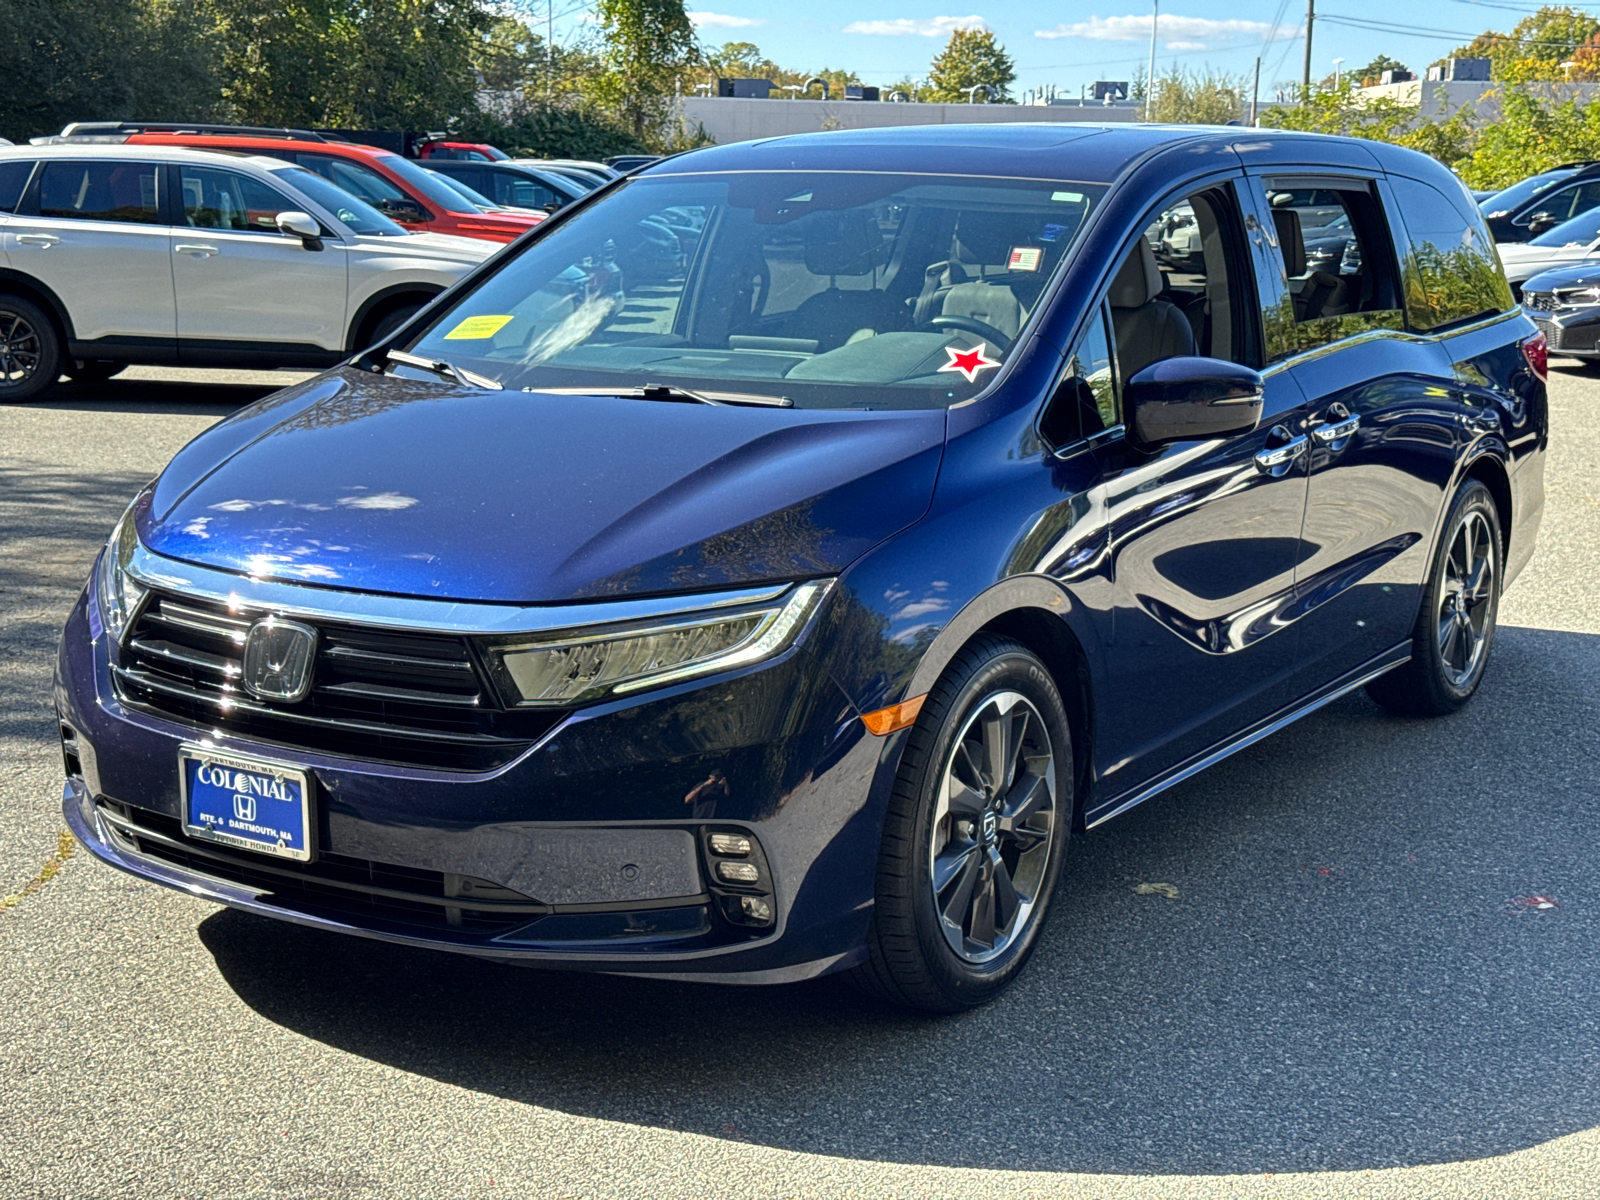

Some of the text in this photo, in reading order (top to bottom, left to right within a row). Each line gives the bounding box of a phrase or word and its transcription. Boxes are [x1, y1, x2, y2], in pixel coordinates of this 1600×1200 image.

[261, 766, 275, 774] MA
[197, 766, 293, 802] COLONIAL
[199, 813, 293, 841] RTE. 6 DARTMOUTH, MA
[250, 841, 278, 854] HONDA
